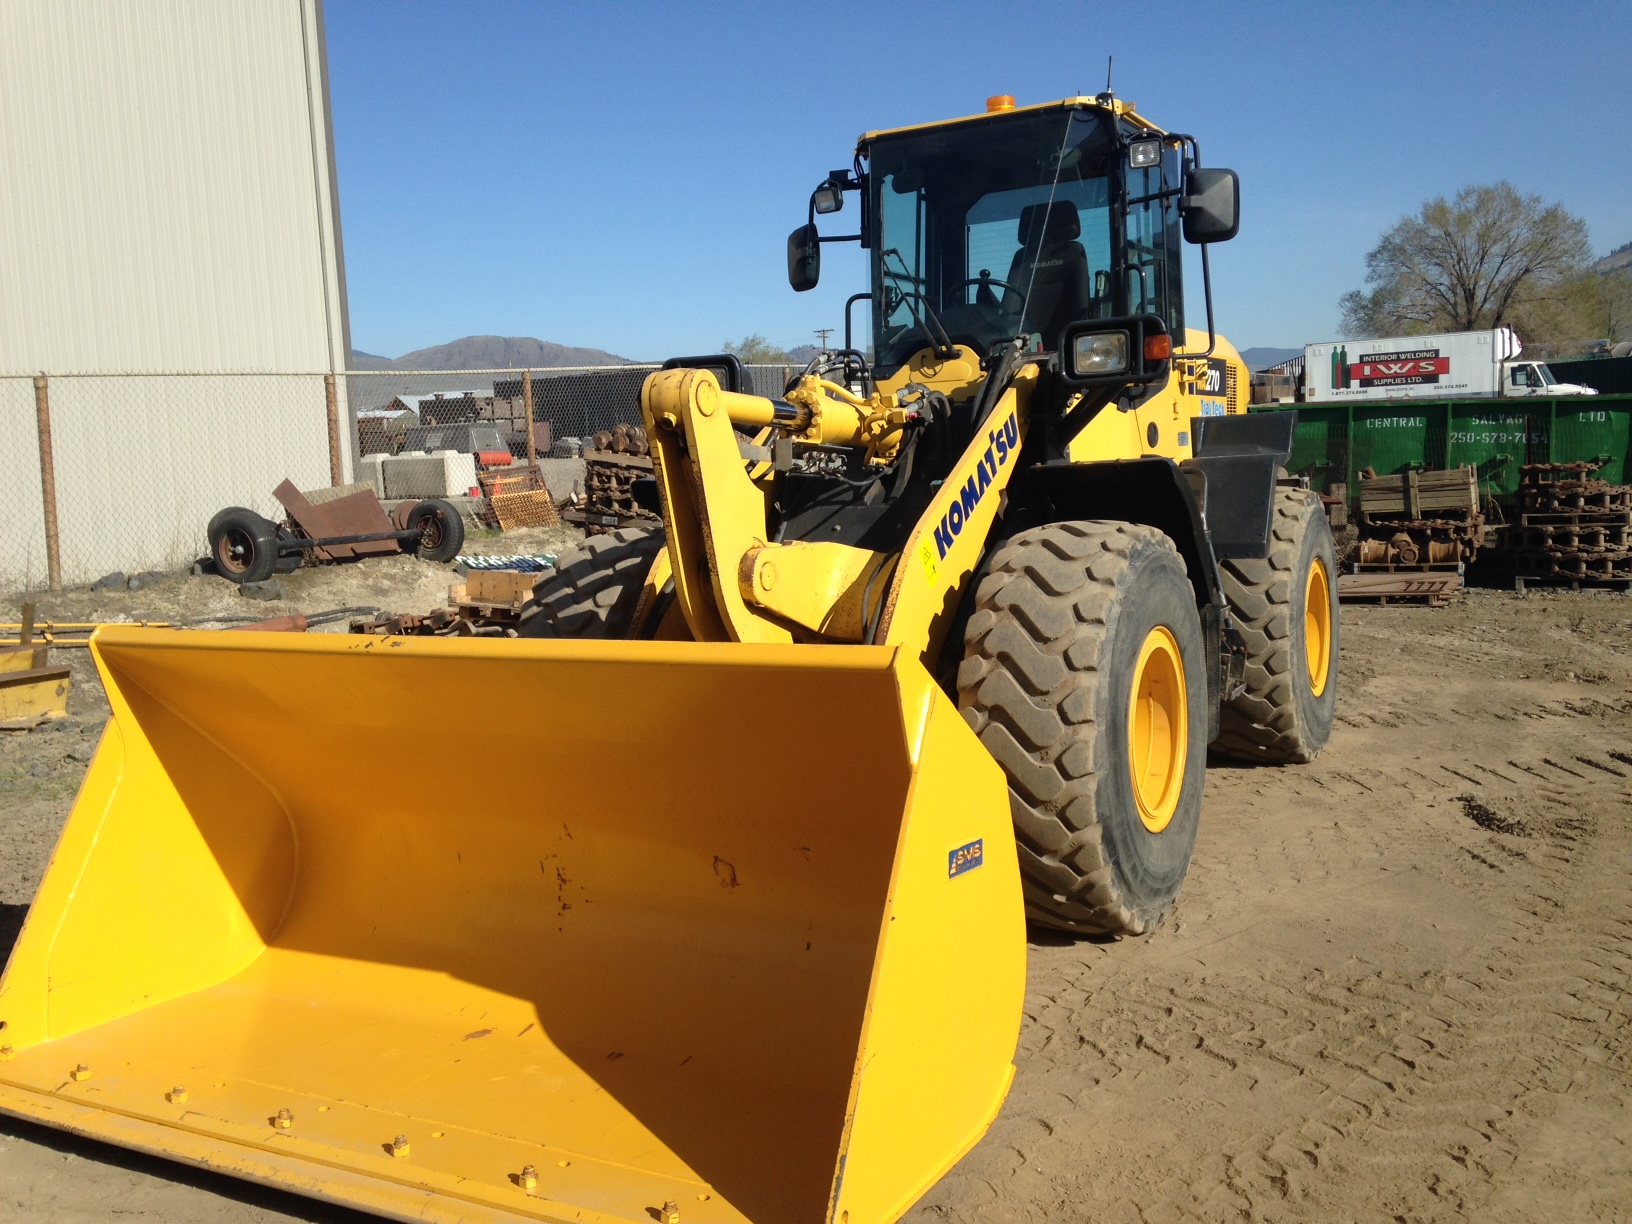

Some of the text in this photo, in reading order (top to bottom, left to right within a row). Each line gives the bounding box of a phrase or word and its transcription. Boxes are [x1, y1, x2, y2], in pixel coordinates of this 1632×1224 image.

[1363, 351, 1436, 362] INTERIOR WELDING
[1373, 375, 1424, 386] SUPPLIES LTD.
[1366, 416, 1423, 428] CENTRAL
[1579, 411, 1606, 422] LTD
[933, 411, 1019, 561] KOMATSU
